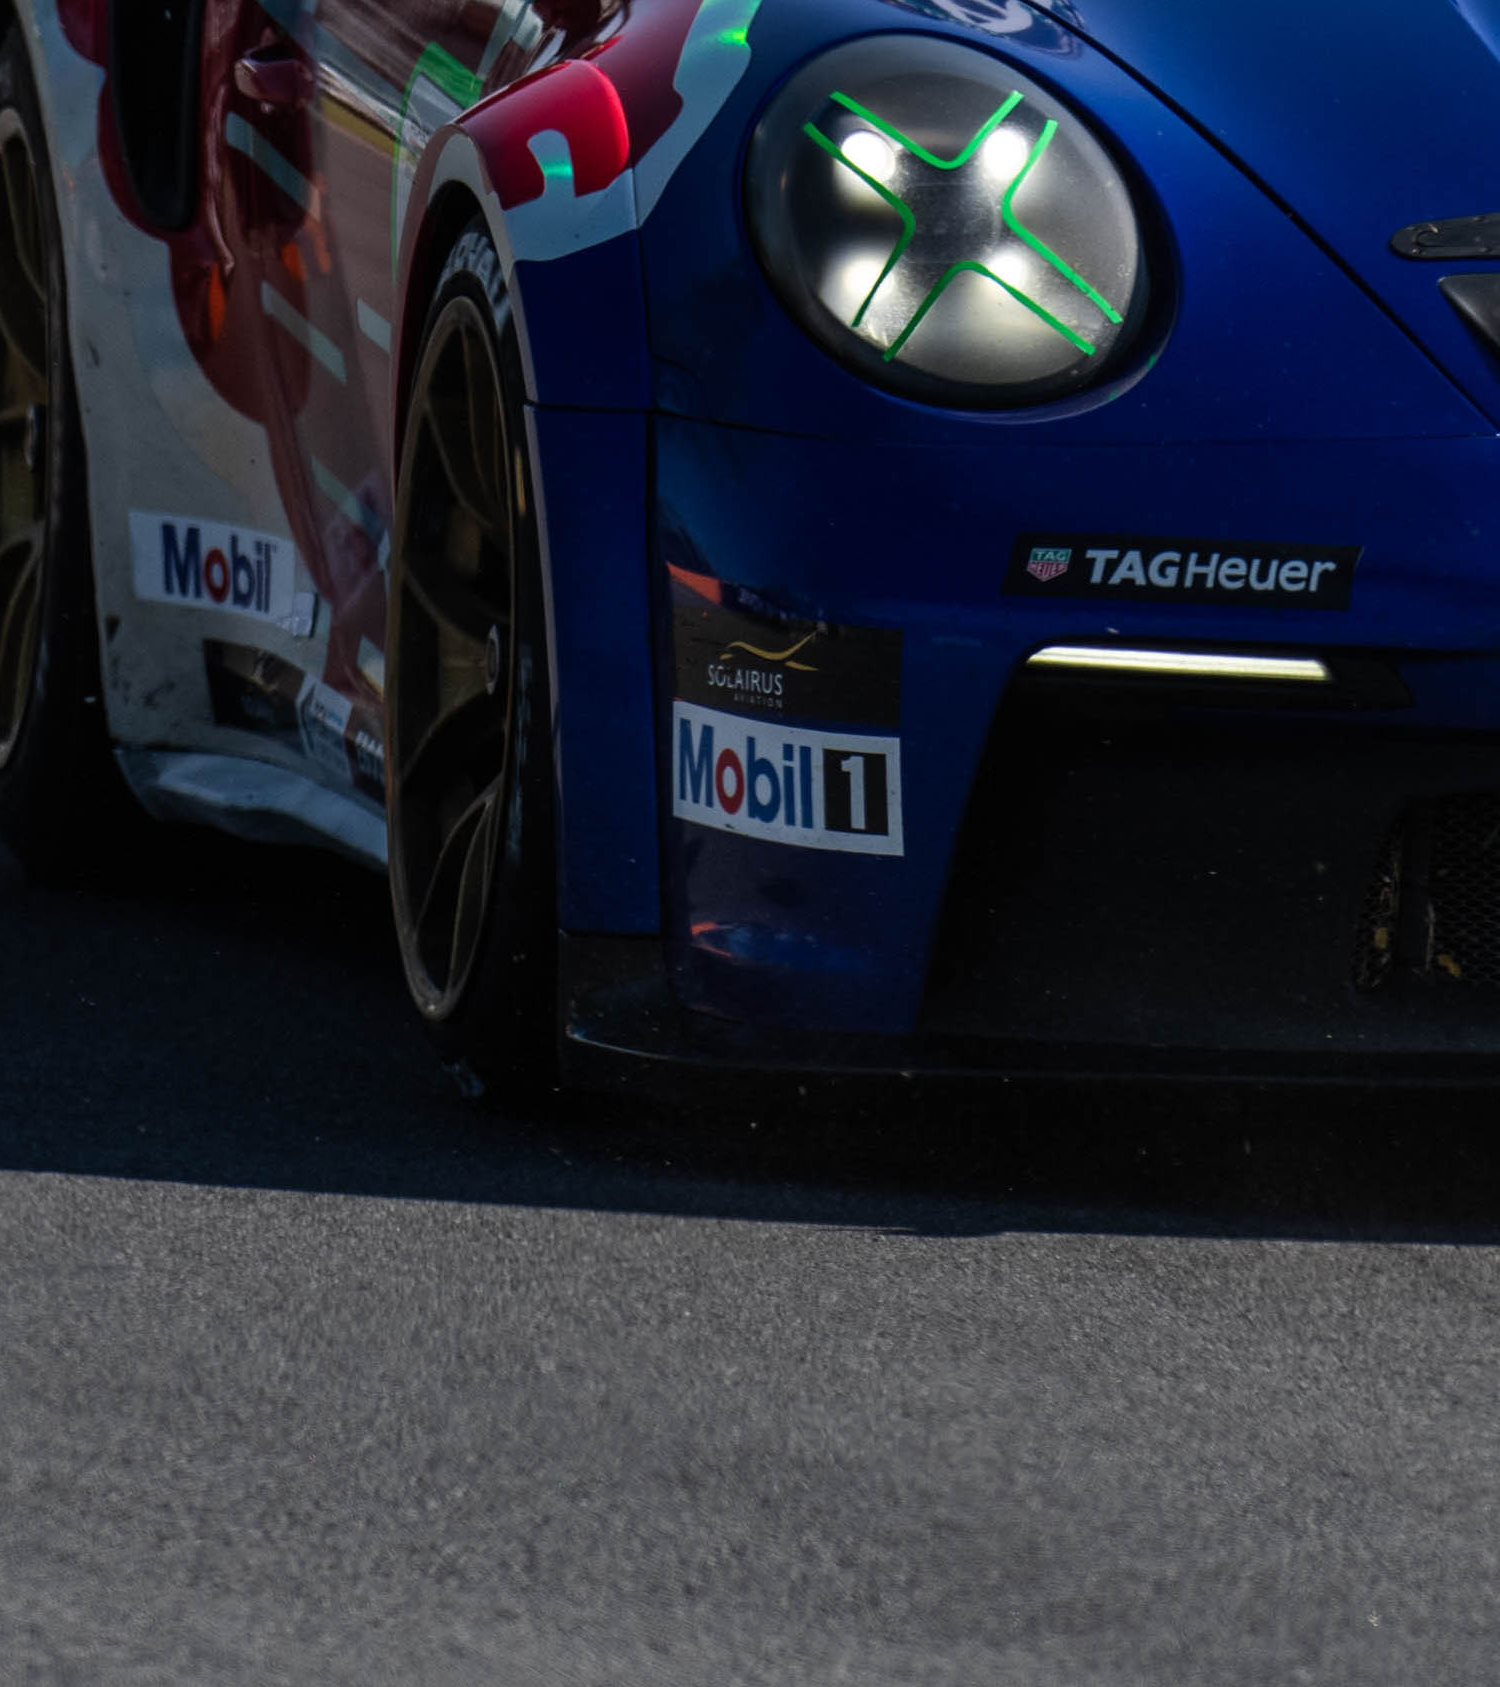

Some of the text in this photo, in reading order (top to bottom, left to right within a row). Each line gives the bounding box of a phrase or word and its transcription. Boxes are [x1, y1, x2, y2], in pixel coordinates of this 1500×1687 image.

[161, 521, 278, 612] Mobil
[707, 664, 783, 696] SOLAIRUS
[679, 718, 868, 830] Mobil 1
